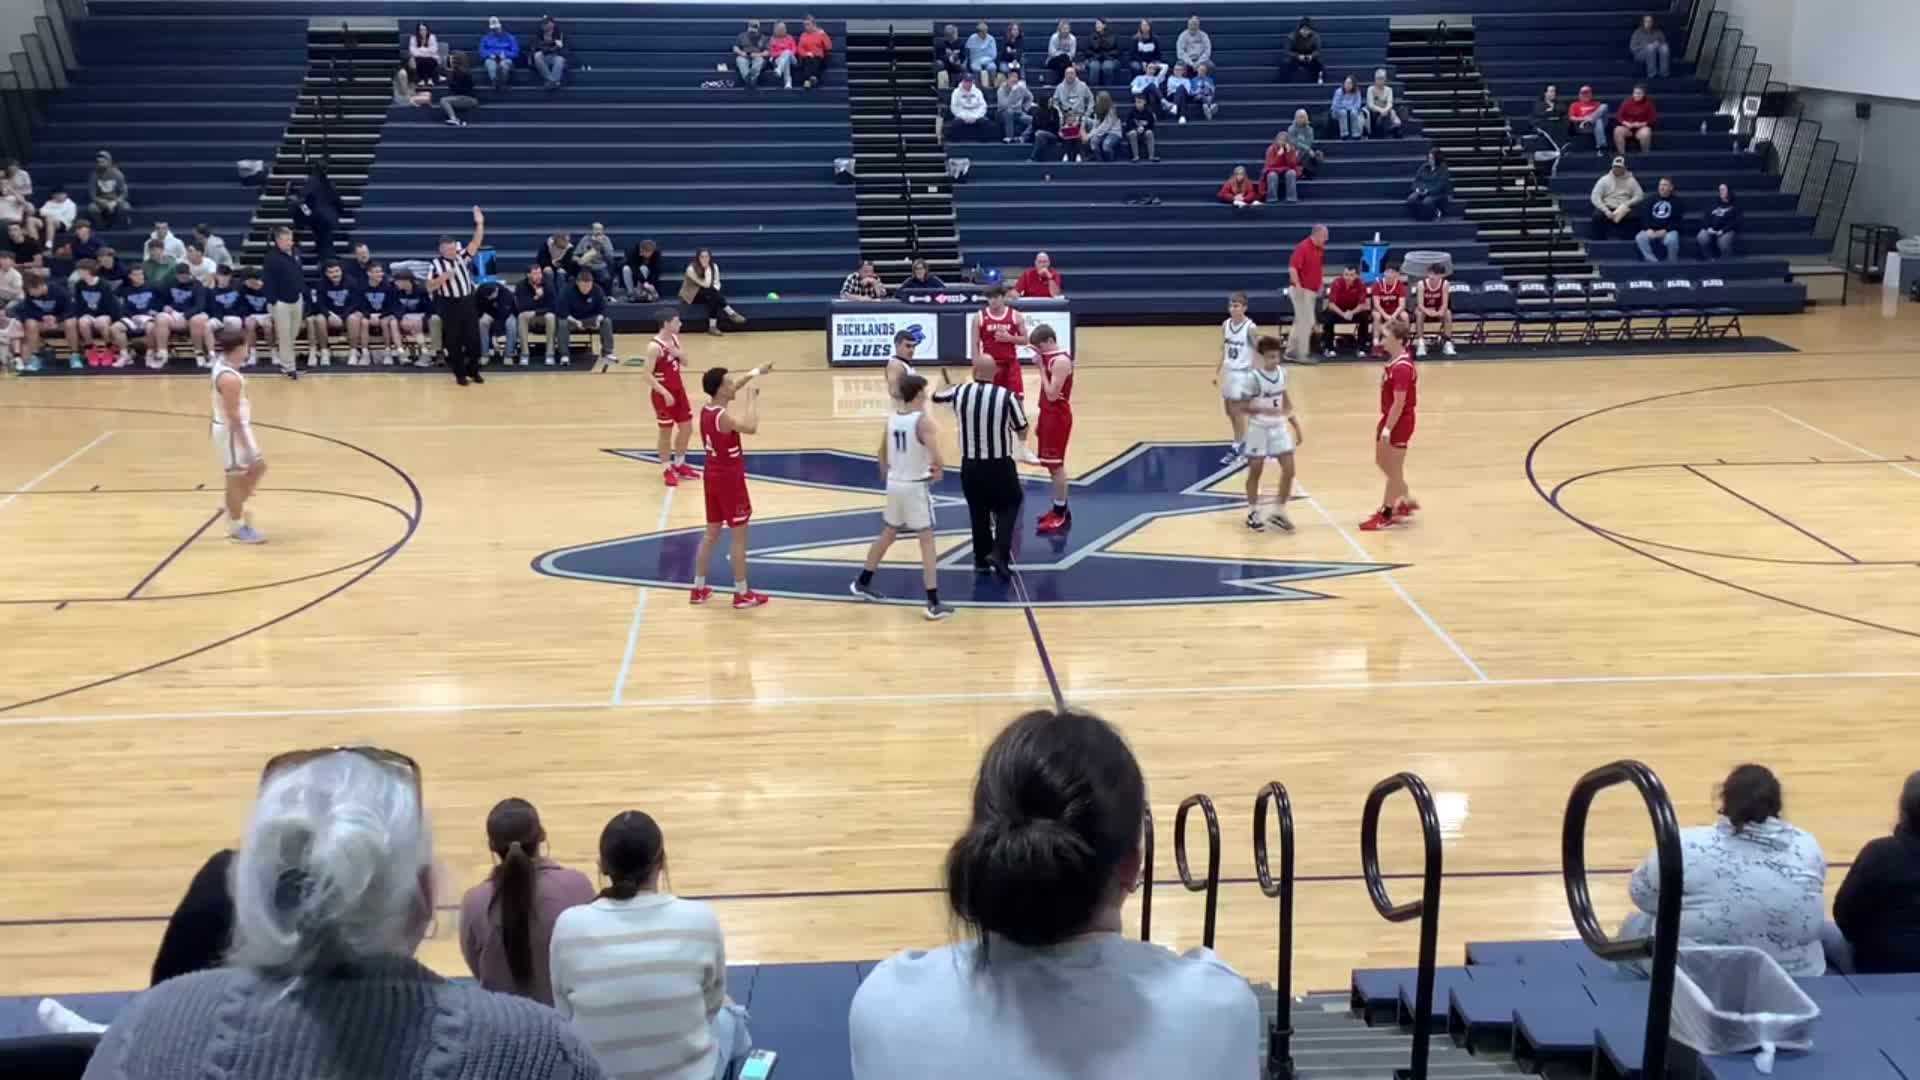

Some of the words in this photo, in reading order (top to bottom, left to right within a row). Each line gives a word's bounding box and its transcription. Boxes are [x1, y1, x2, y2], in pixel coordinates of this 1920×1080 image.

[836, 323, 896, 336] RICHLANDS
[842, 344, 892, 357] BLUES
[894, 430, 907, 453] 11
